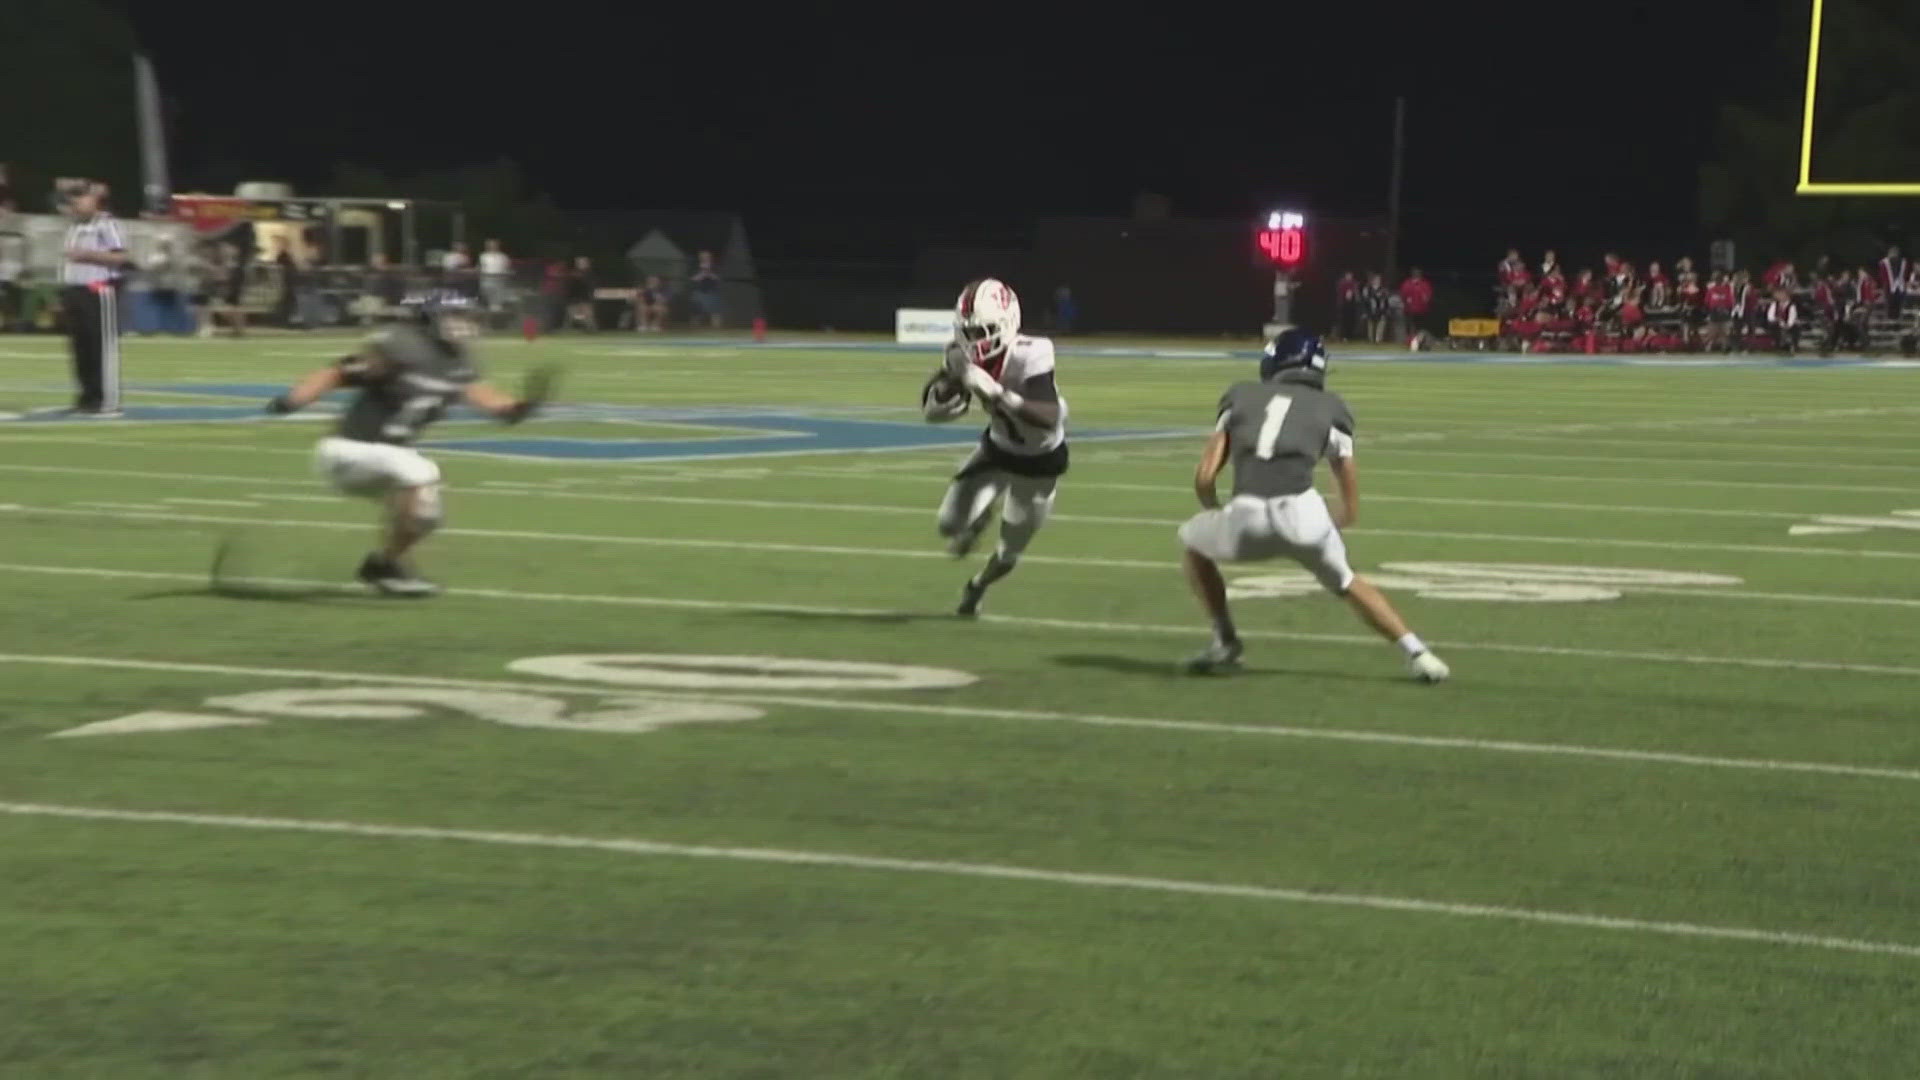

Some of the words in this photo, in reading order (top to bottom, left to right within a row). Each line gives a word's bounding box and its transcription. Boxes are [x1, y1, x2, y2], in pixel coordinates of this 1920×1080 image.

[1260, 231, 1301, 262] 40
[1256, 394, 1292, 460] 1
[203, 654, 978, 733] 20
